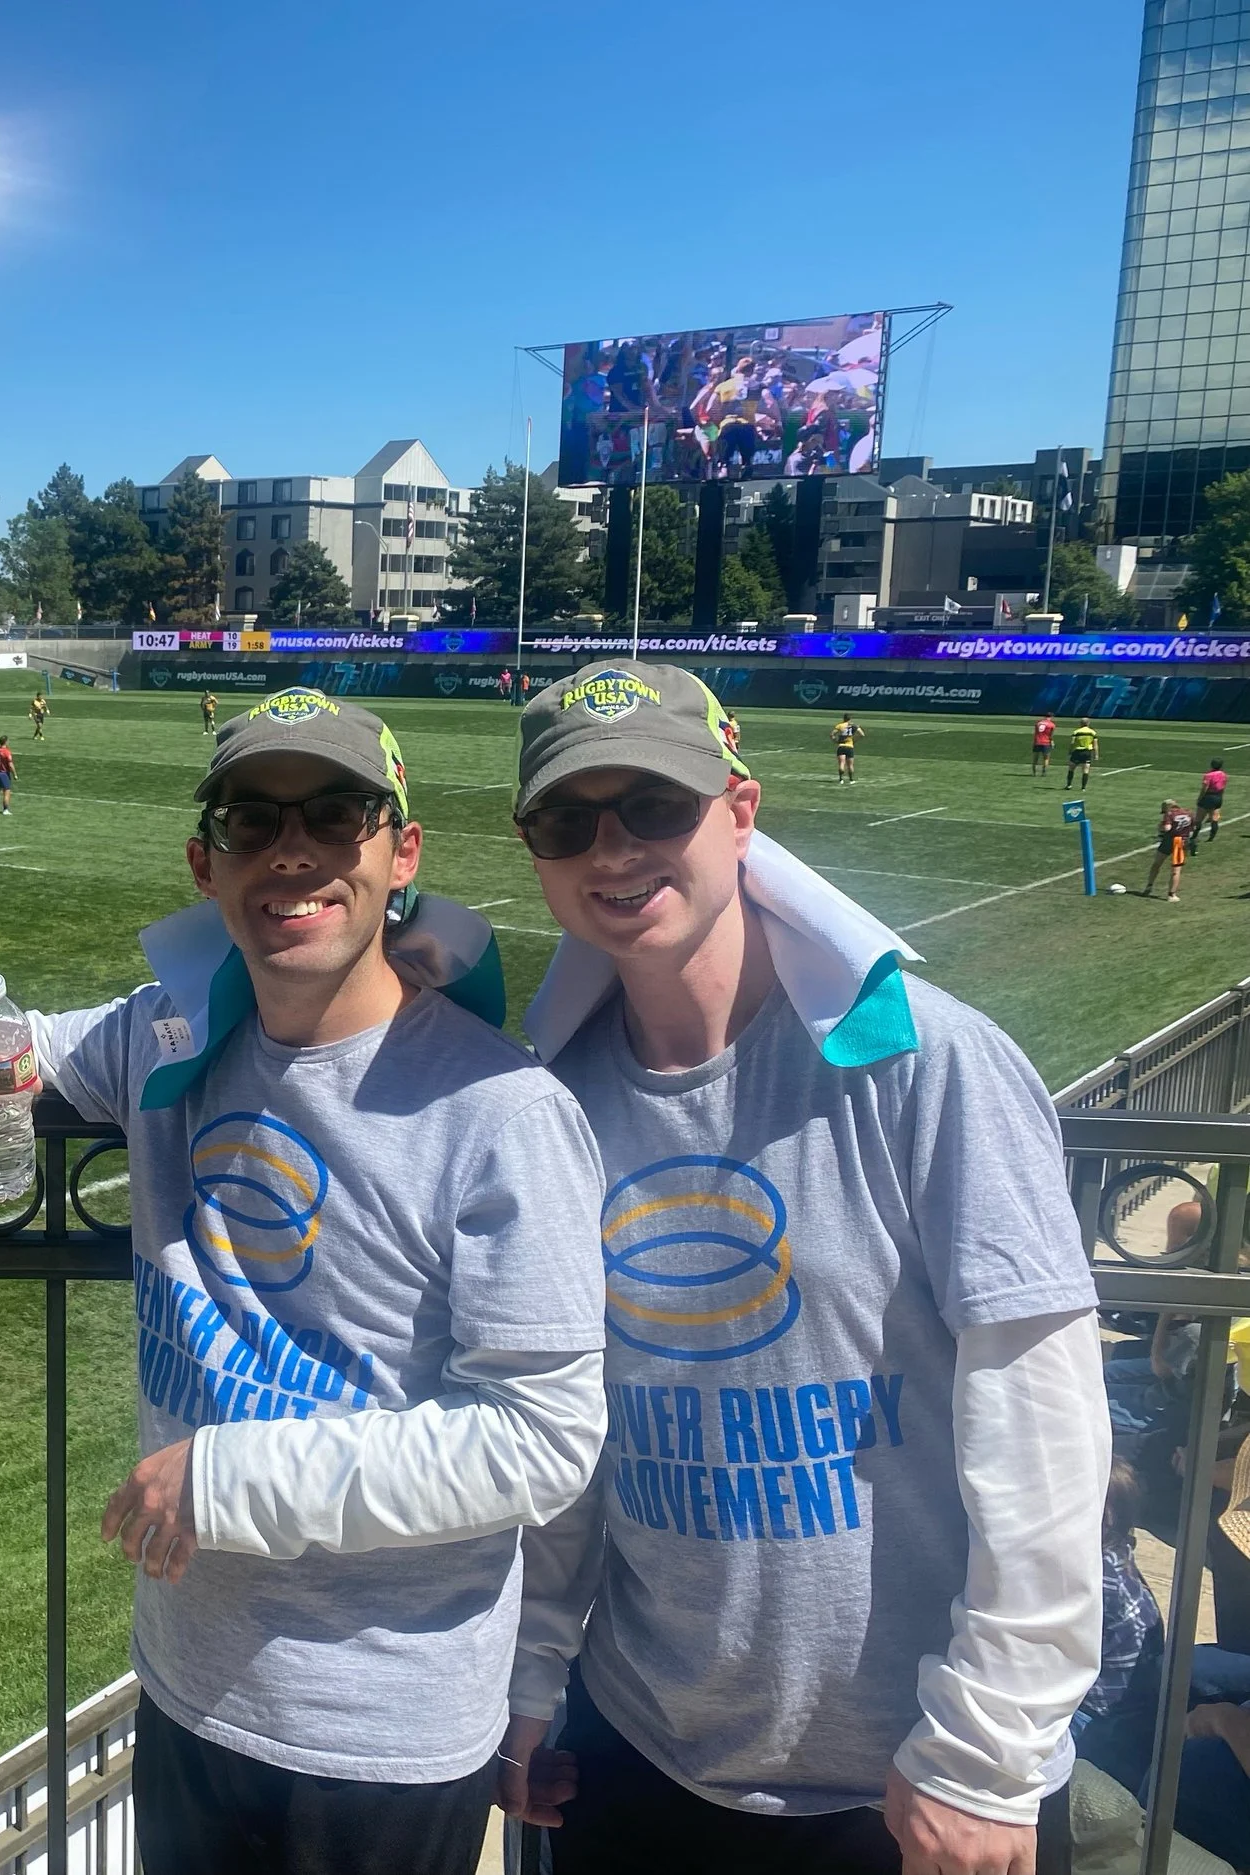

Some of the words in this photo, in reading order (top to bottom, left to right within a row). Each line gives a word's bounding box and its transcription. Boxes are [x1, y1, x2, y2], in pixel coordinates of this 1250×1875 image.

[138, 634, 175, 647] 10:47
[189, 641, 213, 649] ARMY
[533, 634, 778, 653] rugbytownusa.com/tickets
[177, 671, 267, 681] rugbytownUSA.com
[562, 679, 661, 711] RUGBYTOWN
[593, 692, 630, 705] USA
[837, 683, 982, 698] rugbytownUSA.com
[249, 695, 340, 720] RUGBYTOWN
[278, 702, 309, 712] USA
[139, 1327, 317, 1428] MOVEMENT
[606, 1382, 705, 1462] NVER
[720, 1374, 905, 1464] RUGBY
[614, 1456, 861, 1542] MOVEMENT
